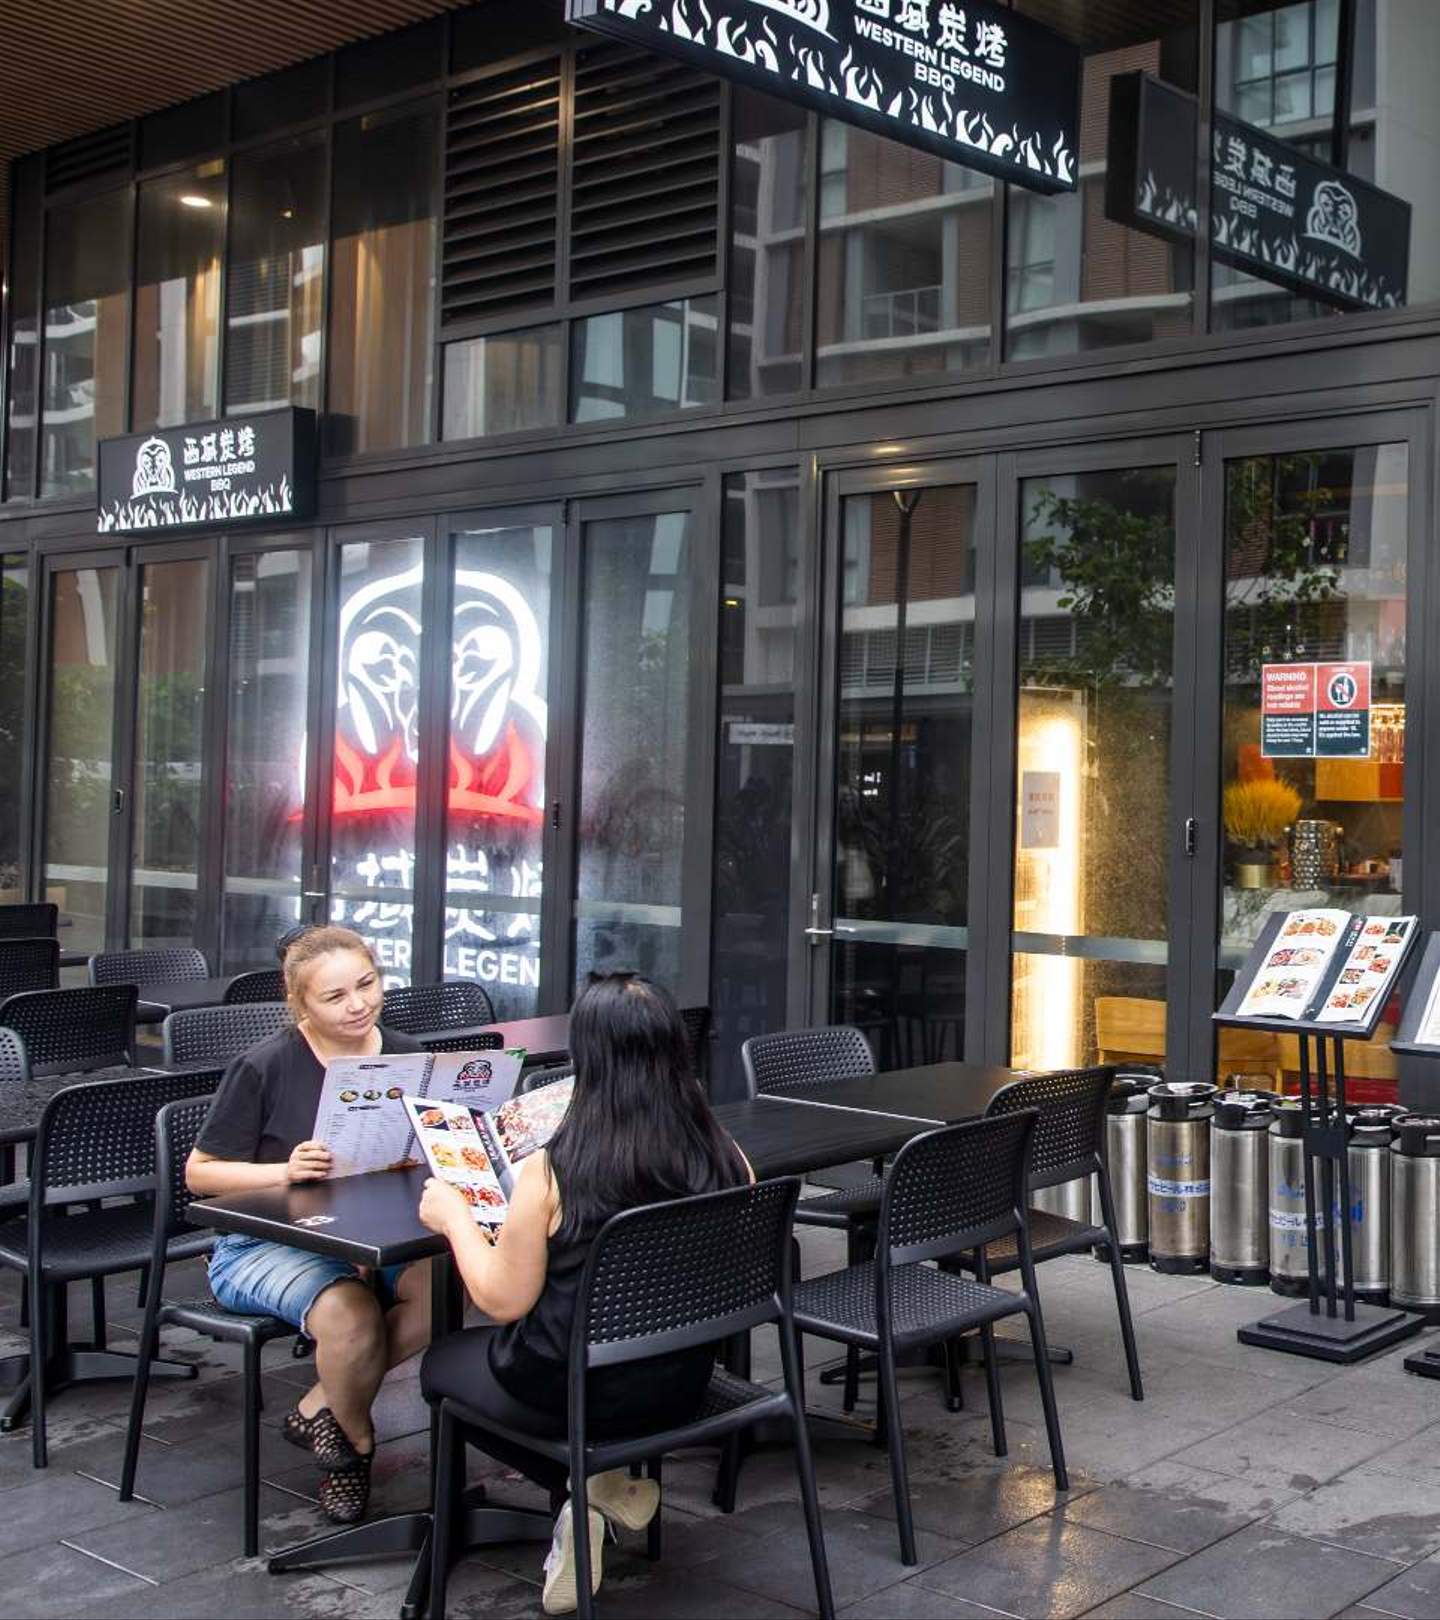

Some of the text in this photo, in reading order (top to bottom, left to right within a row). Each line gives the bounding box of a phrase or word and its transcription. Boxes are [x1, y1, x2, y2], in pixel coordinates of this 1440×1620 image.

[854, 15, 1005, 92] WESTERN LEGEND
[914, 62, 956, 95] BBQ
[184, 460, 255, 481] WESTERN LEGEND
[211, 478, 231, 491] BBQ
[443, 944, 541, 988] LEGEN
